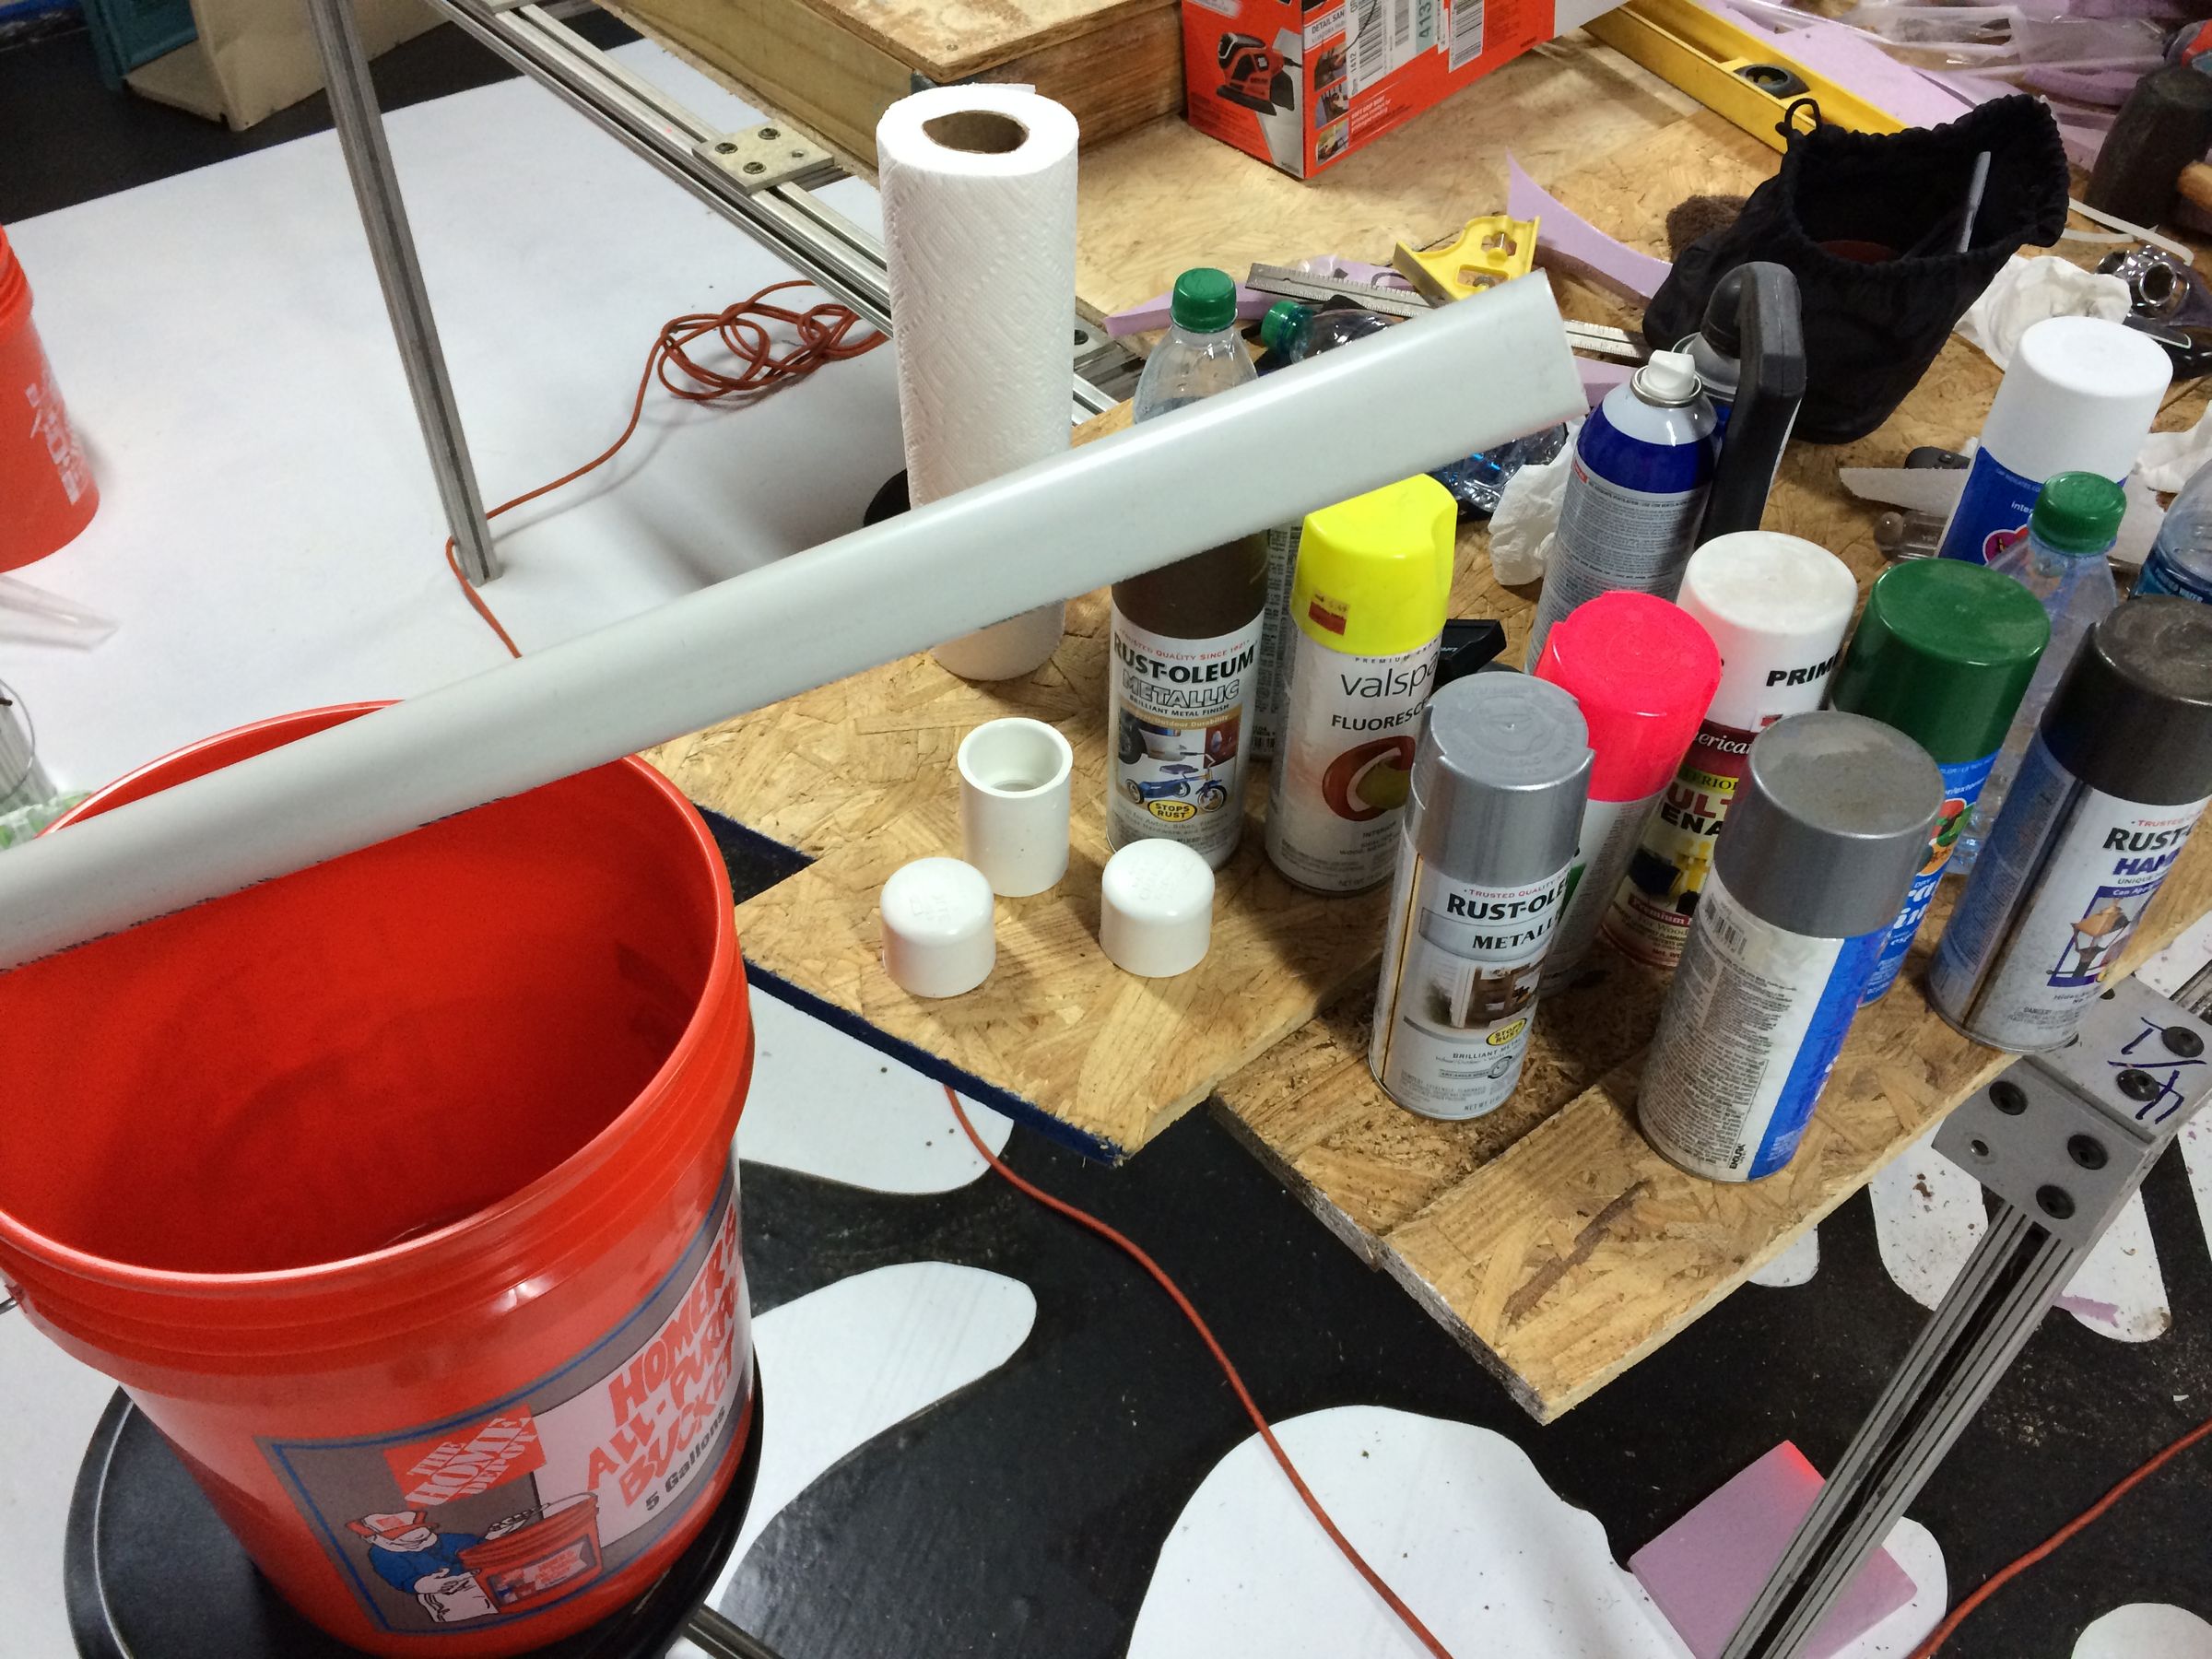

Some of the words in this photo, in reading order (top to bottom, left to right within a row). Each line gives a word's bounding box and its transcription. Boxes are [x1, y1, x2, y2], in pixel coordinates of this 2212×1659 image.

[1113, 630, 1255, 684] RUST-OLEUM
[1156, 649, 1196, 661] QUALITY
[1199, 649, 1228, 661] SINCE
[1355, 653, 1411, 664] PREMIUM
[1765, 654, 1837, 687] PRIM
[1123, 667, 1241, 709] METALLIC
[1129, 693, 1169, 715] BRILLIANT
[1202, 703, 1230, 714] FINISH
[1155, 802, 1190, 812] STOPS
[1157, 810, 1186, 818] RUST
[2102, 822, 2195, 853] RUST-
[1469, 888, 1515, 899] TRUSTED
[1518, 879, 1555, 897] QUALITY
[1913, 877, 1933, 888] DRY
[2117, 875, 2153, 885] UNIQUE
[1494, 1021, 1523, 1039] STOPS
[1495, 1026, 1521, 1044] RUST
[1453, 1048, 1499, 1060] BRILLIANT
[618, 1321, 735, 1508] BUCKET
[404, 1417, 534, 1506] HOME
[406, 1441, 468, 1477] THE
[457, 1430, 540, 1495] DEPOT
[645, 1492, 660, 1512] 5
[665, 1405, 726, 1494] Gallons
